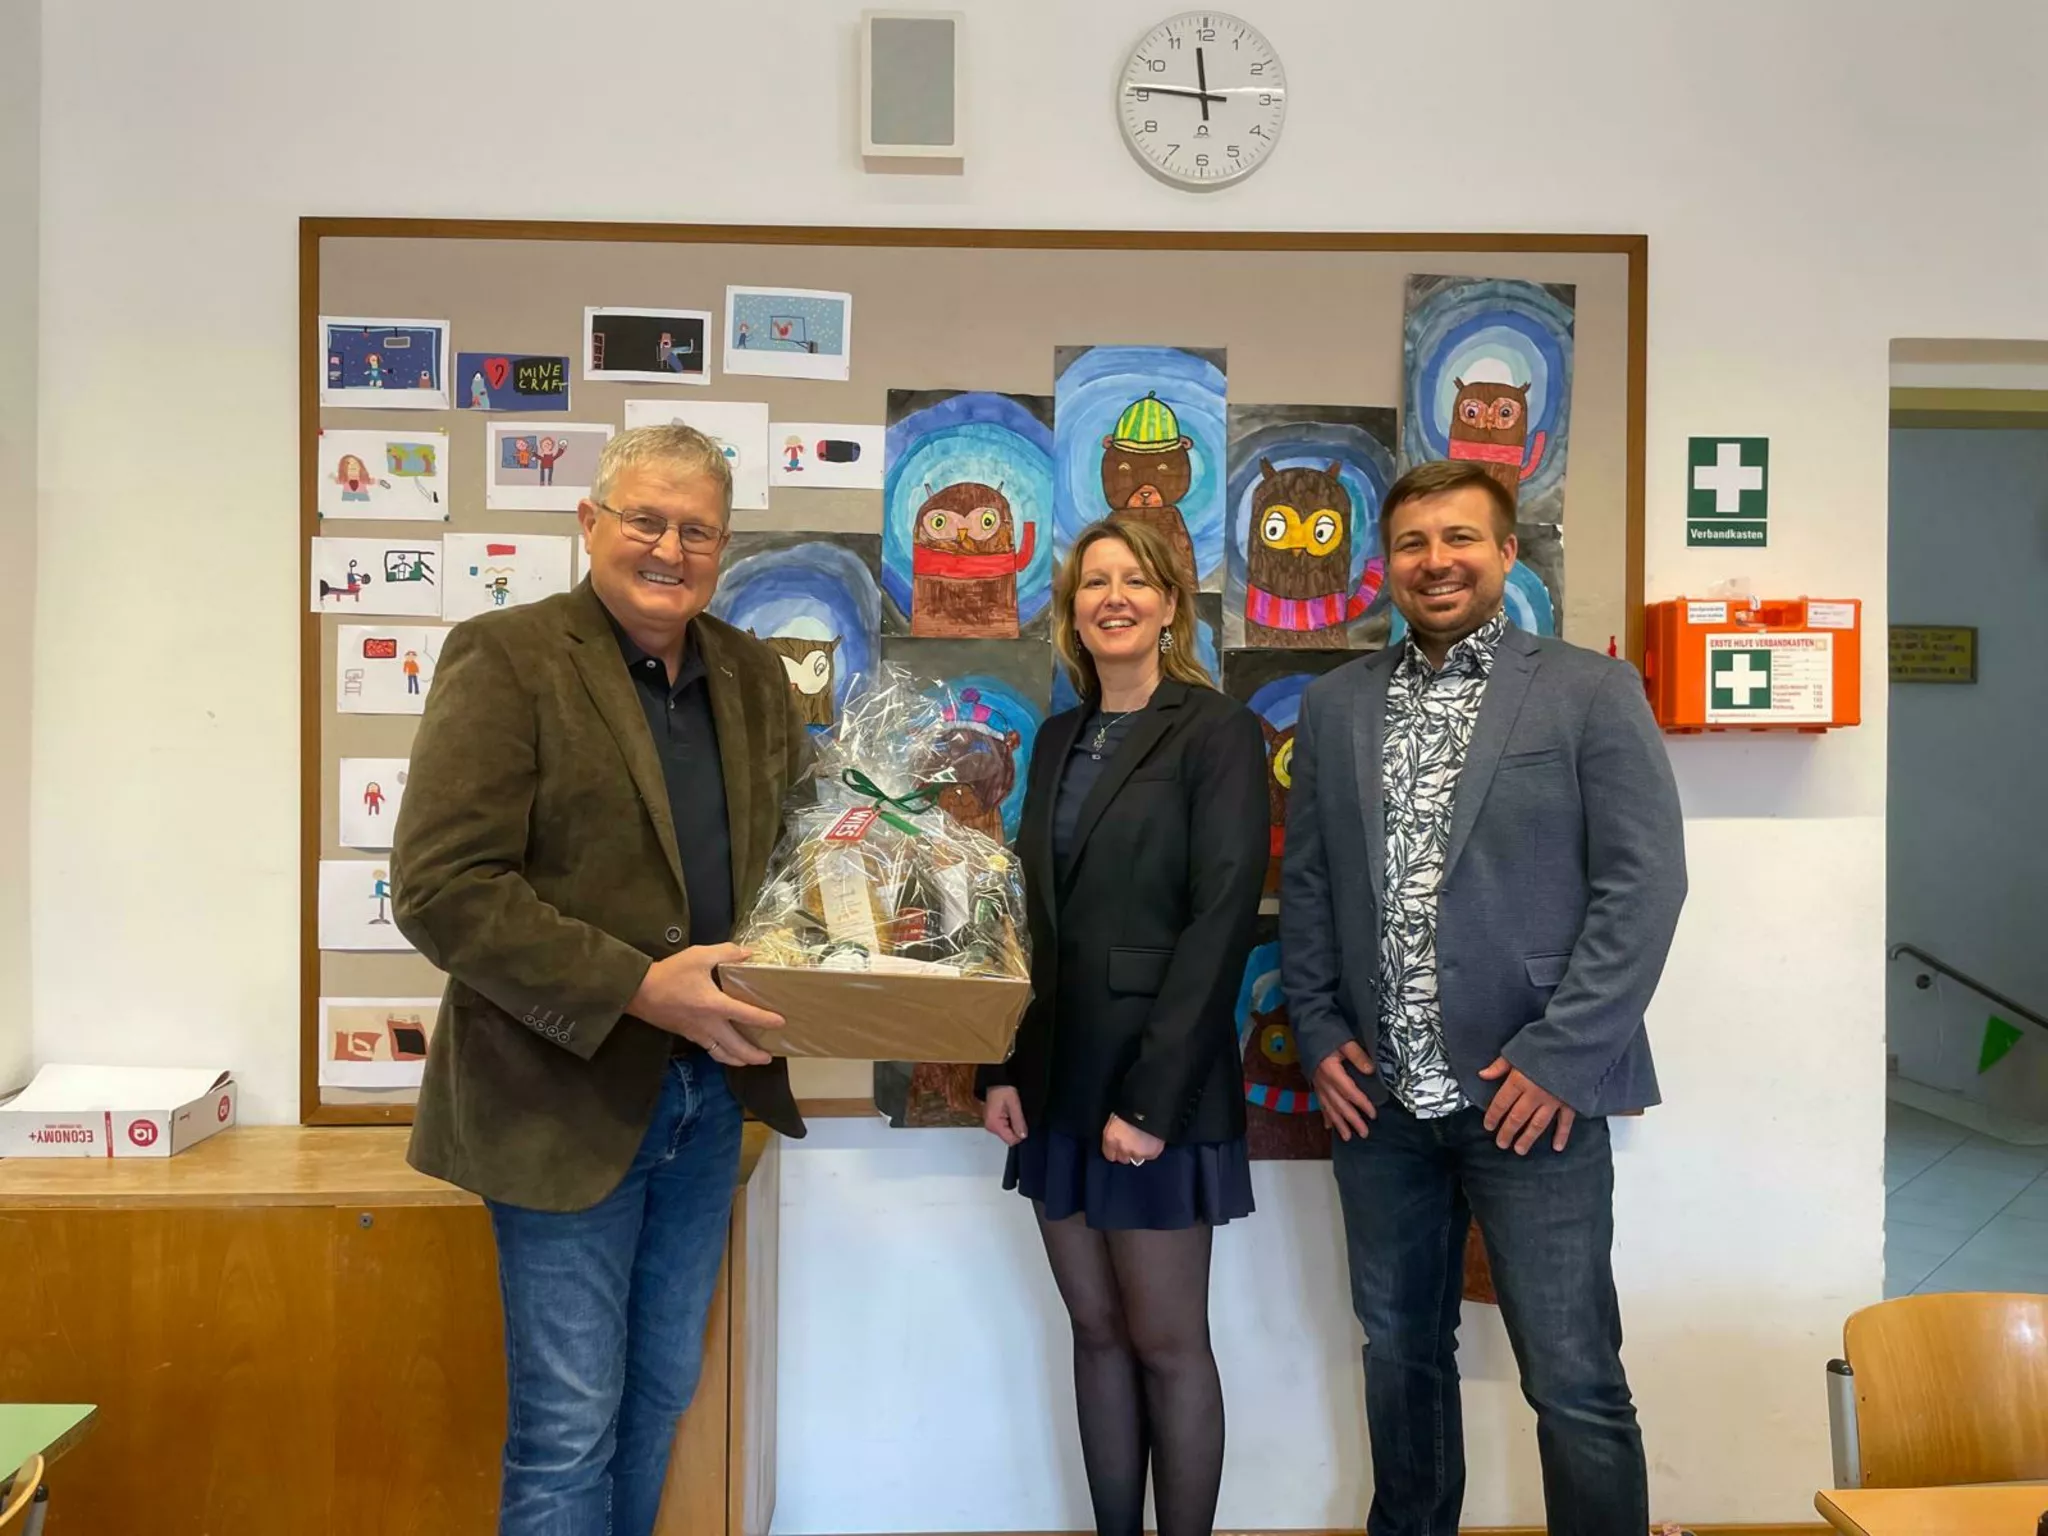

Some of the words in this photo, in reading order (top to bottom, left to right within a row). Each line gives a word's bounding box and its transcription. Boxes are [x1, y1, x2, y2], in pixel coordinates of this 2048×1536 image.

[1196, 29, 1216, 42] 12
[1168, 37, 1181, 49] 11
[1232, 39, 1239, 50] 1
[1145, 59, 1166, 72] 10
[1250, 63, 1263, 75] 2
[1136, 90, 1149, 102] 9
[1259, 94, 1271, 106] 3
[1144, 120, 1157, 133] 8
[1249, 125, 1261, 136] 4
[1167, 144, 1180, 156] 7
[1227, 145, 1240, 158] 5
[1196, 154, 1209, 166] 6
[520, 363, 562, 379] MINE
[519, 379, 567, 392] CRAFT
[1691, 528, 1764, 540] Verbandkasten
[1710, 639, 1732, 648] ERSTE
[1733, 639, 1753, 648] HILFE
[1755, 638, 1814, 647] VERBANDKASTEN
[835, 810, 873, 837] WIES
[29, 1129, 94, 1143] ECONOMY+
[133, 1127, 153, 1141] IQ
